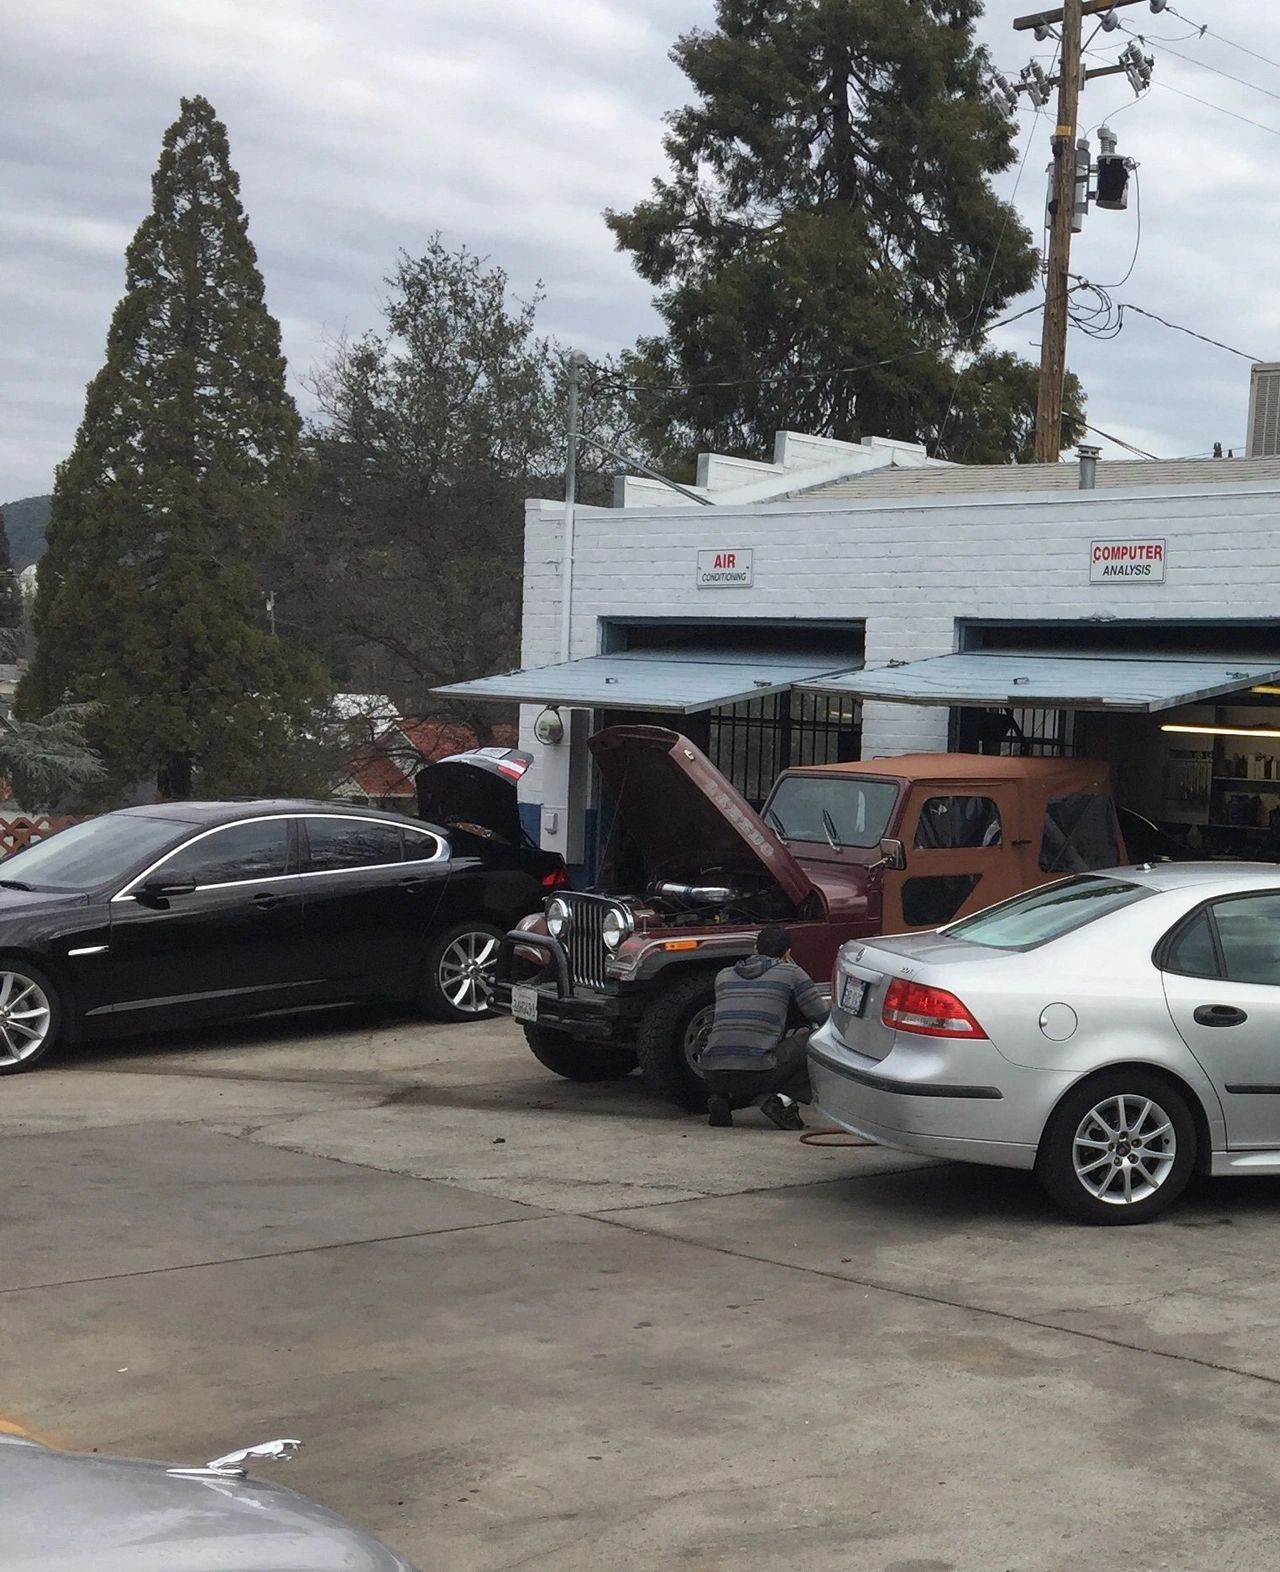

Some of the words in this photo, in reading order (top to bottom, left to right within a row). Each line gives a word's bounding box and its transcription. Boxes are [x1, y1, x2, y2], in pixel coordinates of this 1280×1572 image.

[1093, 545, 1162, 561] COMPUTER
[713, 554, 736, 569] AIR
[1102, 564, 1152, 576] ANALYSIS
[701, 572, 747, 582] CONDITIONING
